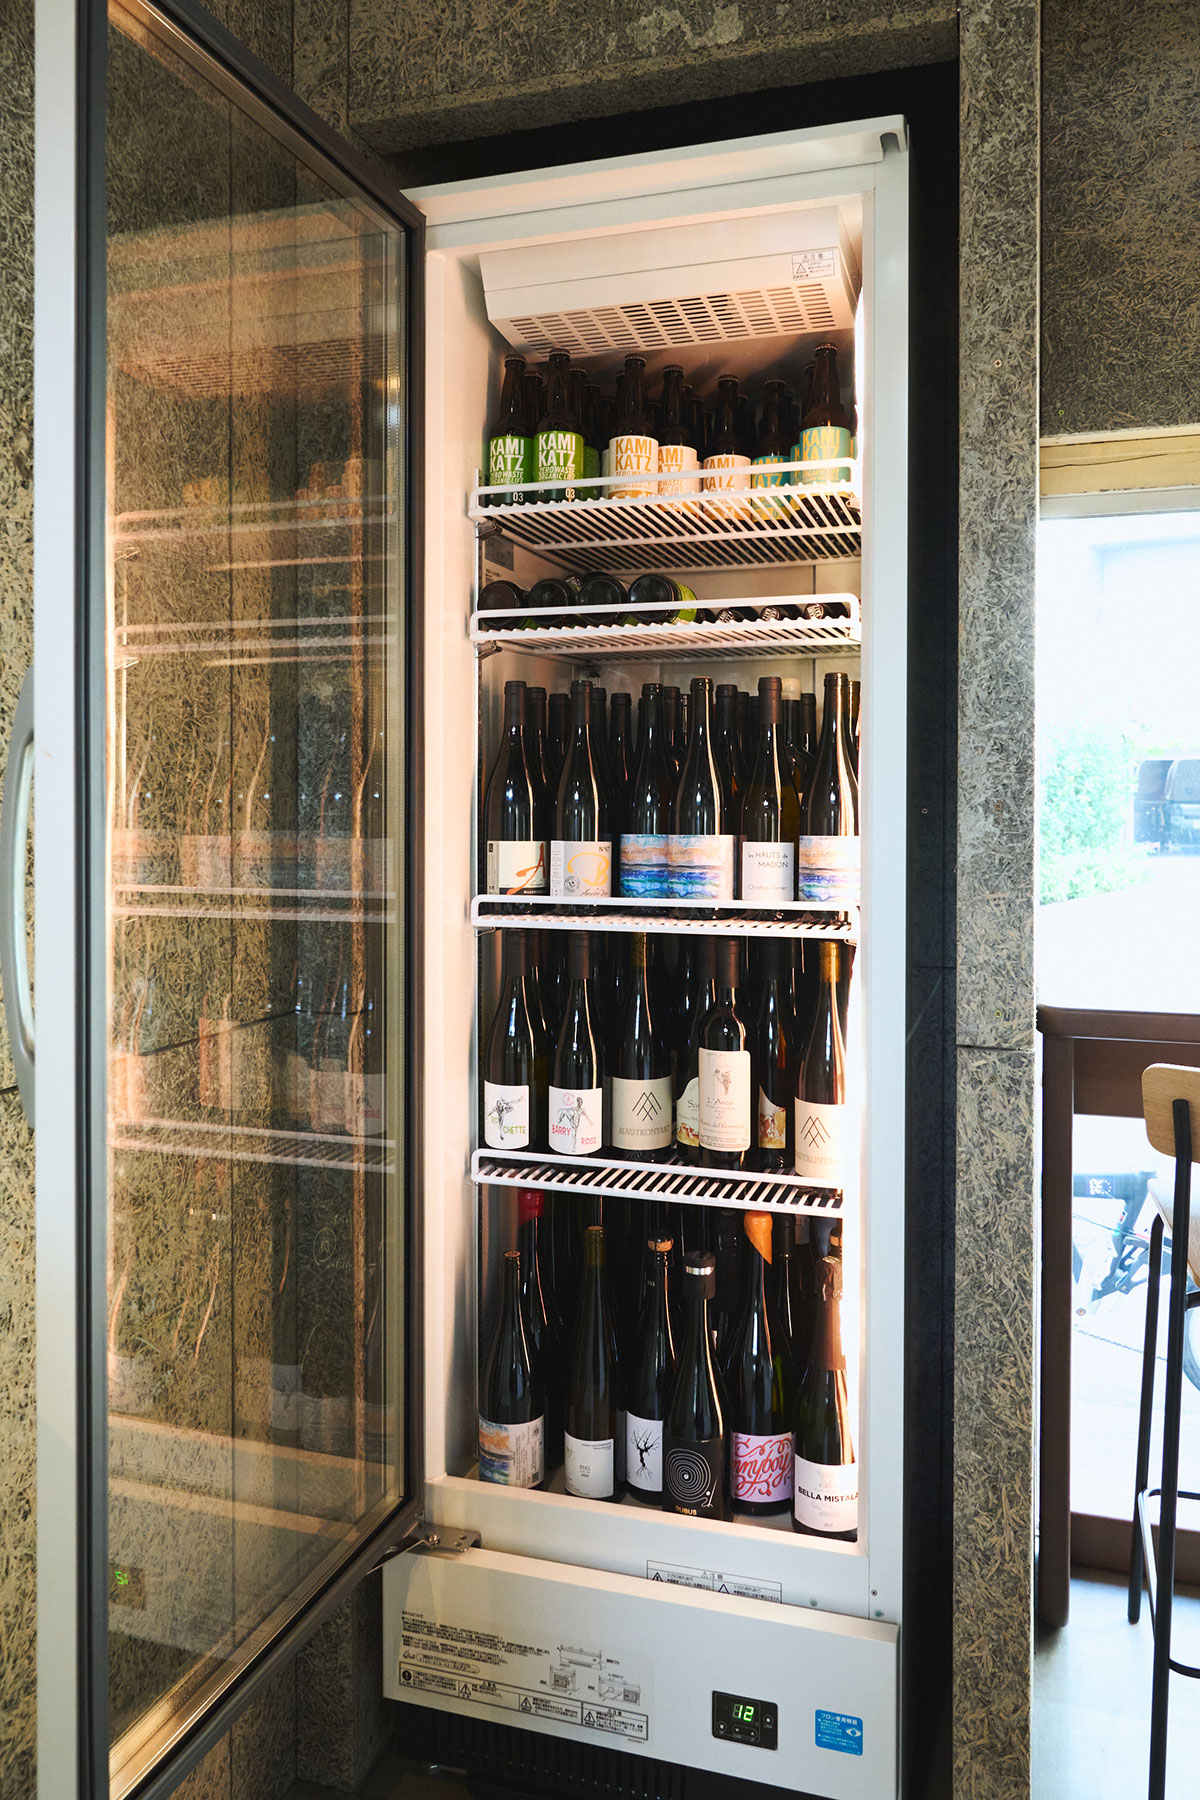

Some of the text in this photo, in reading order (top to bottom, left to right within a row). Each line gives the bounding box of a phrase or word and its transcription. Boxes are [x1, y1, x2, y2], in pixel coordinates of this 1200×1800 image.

[539, 432, 576, 452] KAMI
[803, 428, 841, 449] KAMI
[490, 438, 525, 457] KAMI
[615, 438, 652, 456] KAMI
[539, 449, 576, 468] KATZ
[658, 447, 684, 464] AMI
[490, 454, 525, 473] KATZ
[554, 466, 575, 474] WASTE
[615, 454, 652, 472] KATZ
[658, 464, 684, 473] ATZ
[503, 470, 525, 479] WASTE
[513, 491, 524, 502] 03
[565, 487, 576, 498] 03
[755, 851, 781, 859] HAUTS
[758, 861, 789, 869] MADON
[503, 1126, 527, 1135] CHETTE
[551, 1124, 572, 1137] BARRY
[581, 1137, 598, 1145] ROSE
[798, 1486, 822, 1501] BELLA
[736, 1704, 755, 1722] 12
